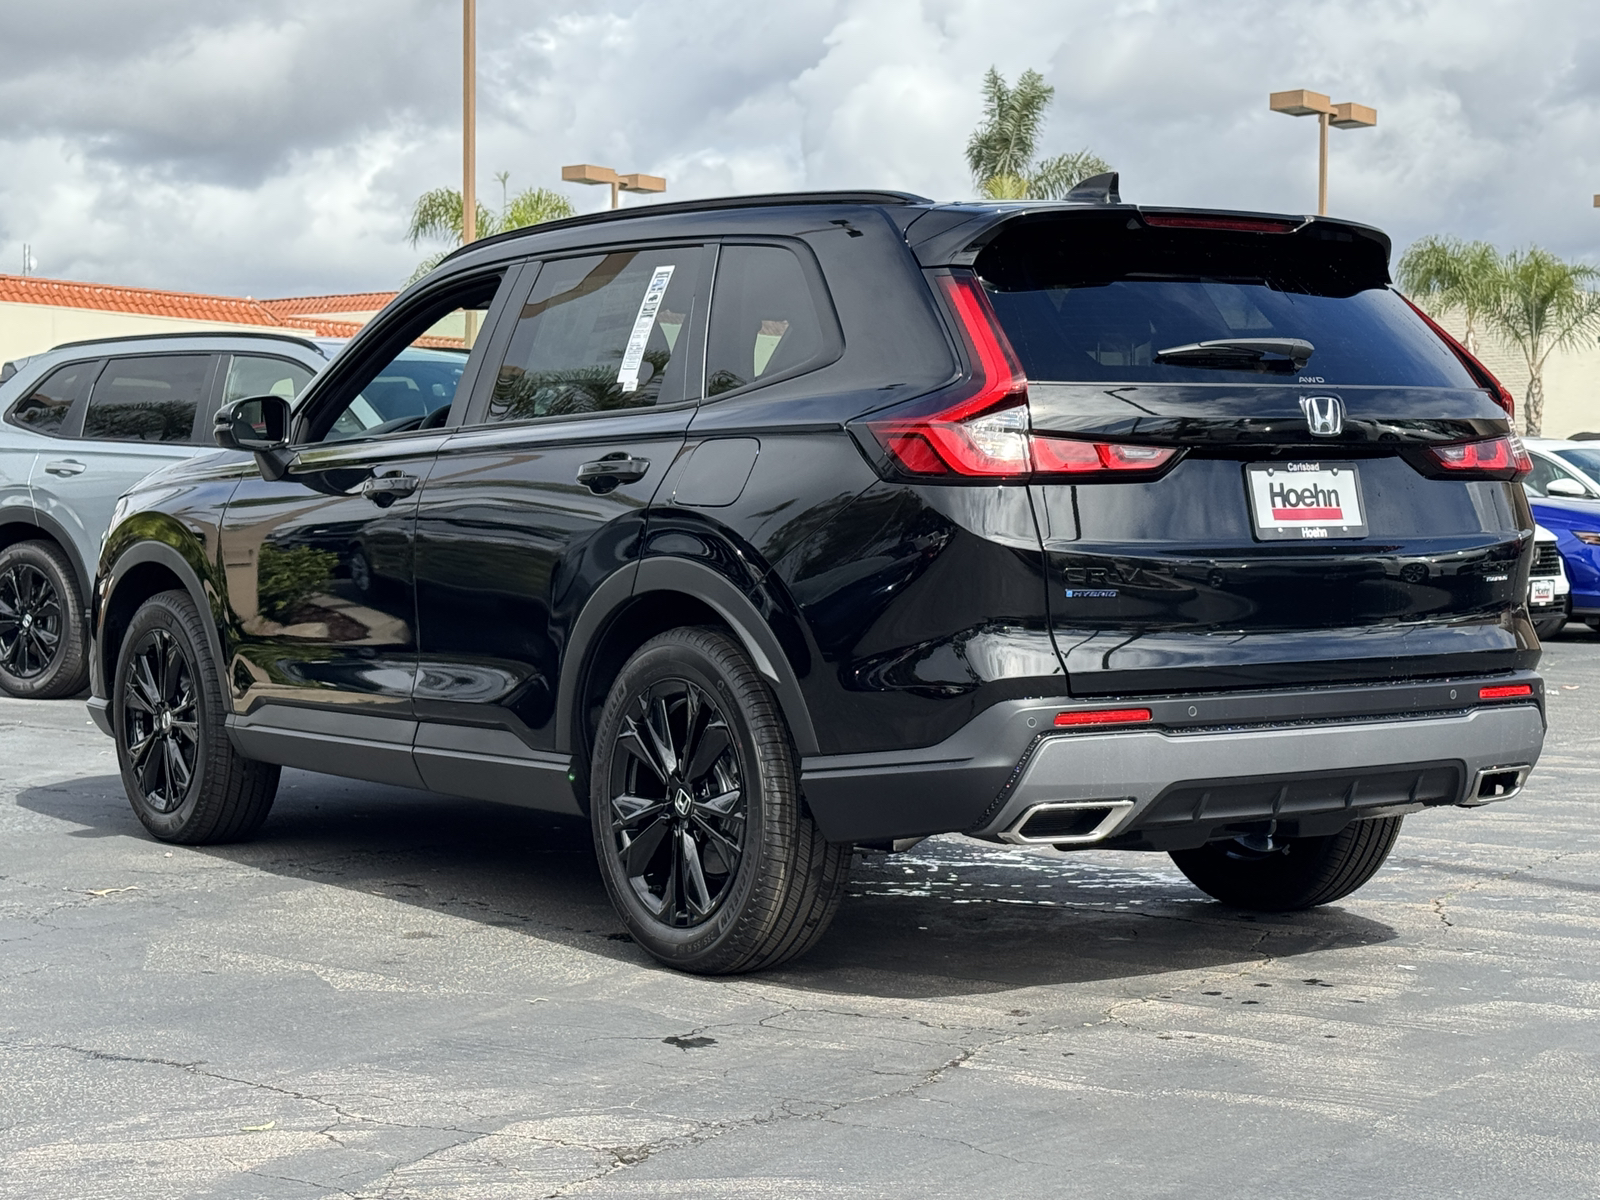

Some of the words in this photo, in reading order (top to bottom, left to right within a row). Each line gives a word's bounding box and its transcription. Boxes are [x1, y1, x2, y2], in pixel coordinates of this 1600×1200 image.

[1298, 376, 1325, 384] AWD
[1287, 462, 1320, 472] Carlsbad
[1269, 482, 1341, 508] Hoehn
[1301, 527, 1328, 538] Hoehn
[1062, 567, 1140, 584] CR-V
[597, 682, 626, 759] MICHELIN
[721, 850, 752, 928] MICHELIN
